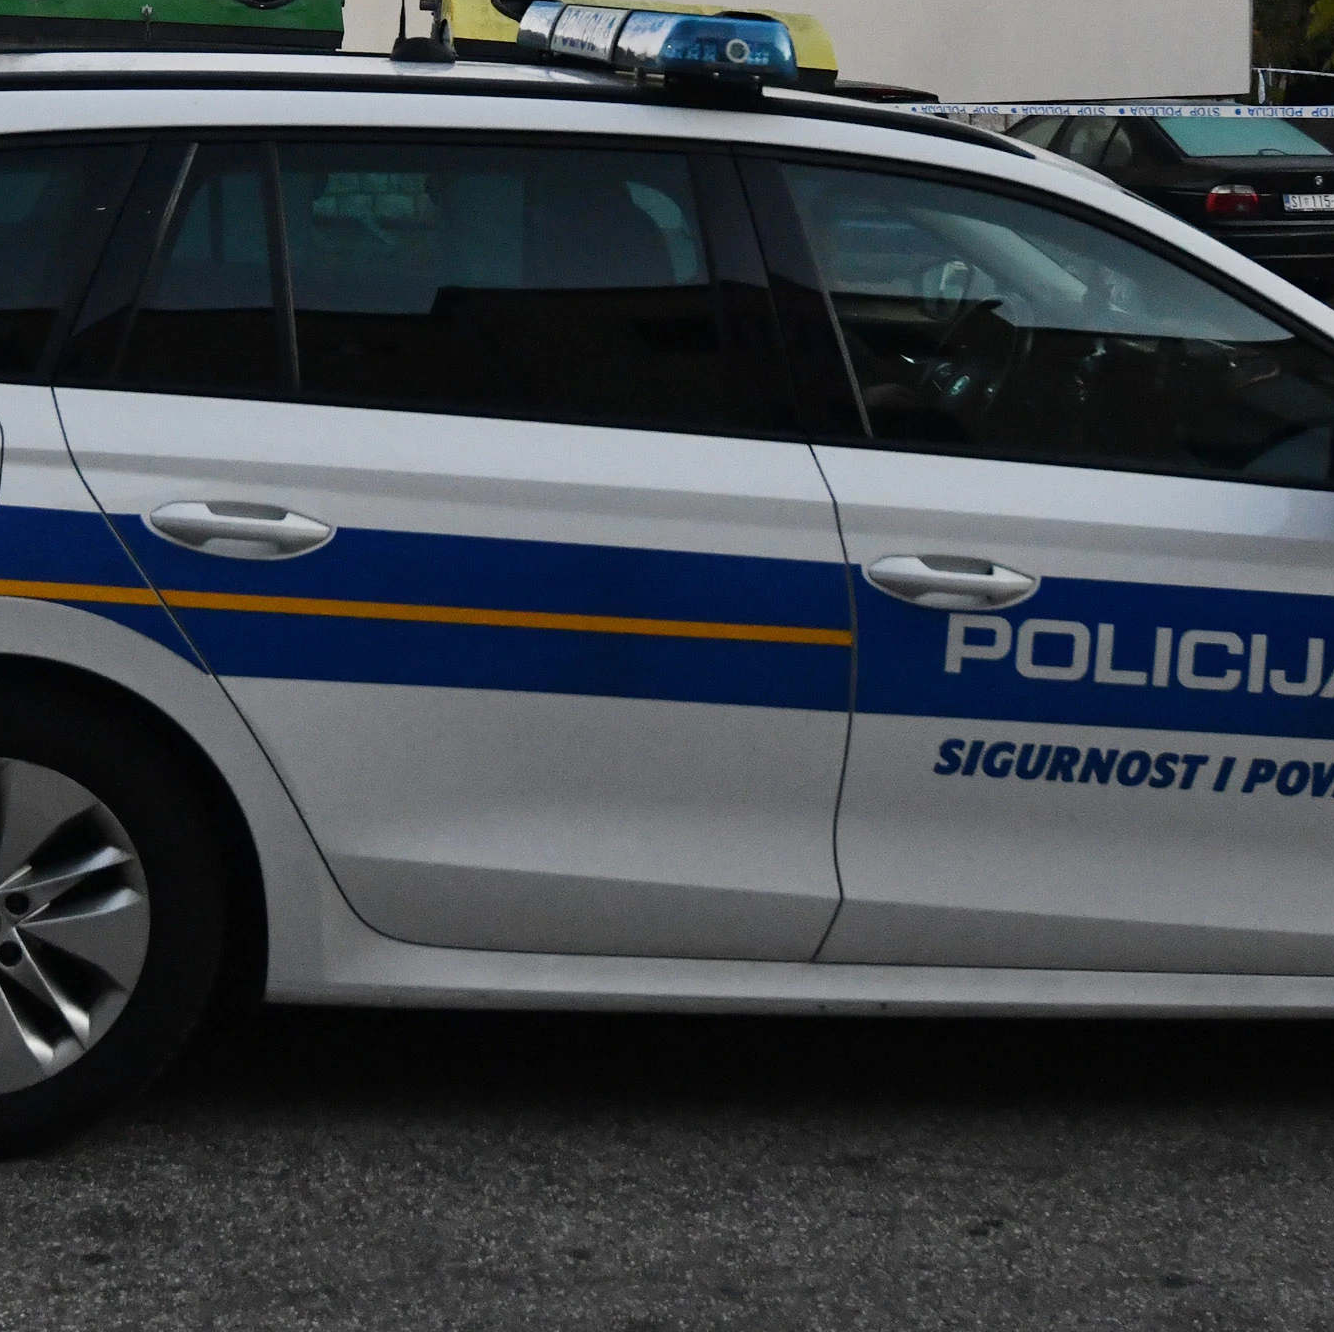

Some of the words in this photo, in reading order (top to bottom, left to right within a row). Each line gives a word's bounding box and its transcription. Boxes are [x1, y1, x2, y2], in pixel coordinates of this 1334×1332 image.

[973, 106, 999, 114] STOP
[1021, 106, 1072, 115] POLICIJA
[1077, 106, 1107, 115] STOP
[1130, 106, 1182, 116] POLICIJA
[1189, 106, 1221, 116] STOP
[1247, 106, 1303, 117] POLICIJA
[1291, 195, 1301, 207] SI
[934, 738, 1209, 791] SIGURNOST
[1212, 757, 1234, 792] I
